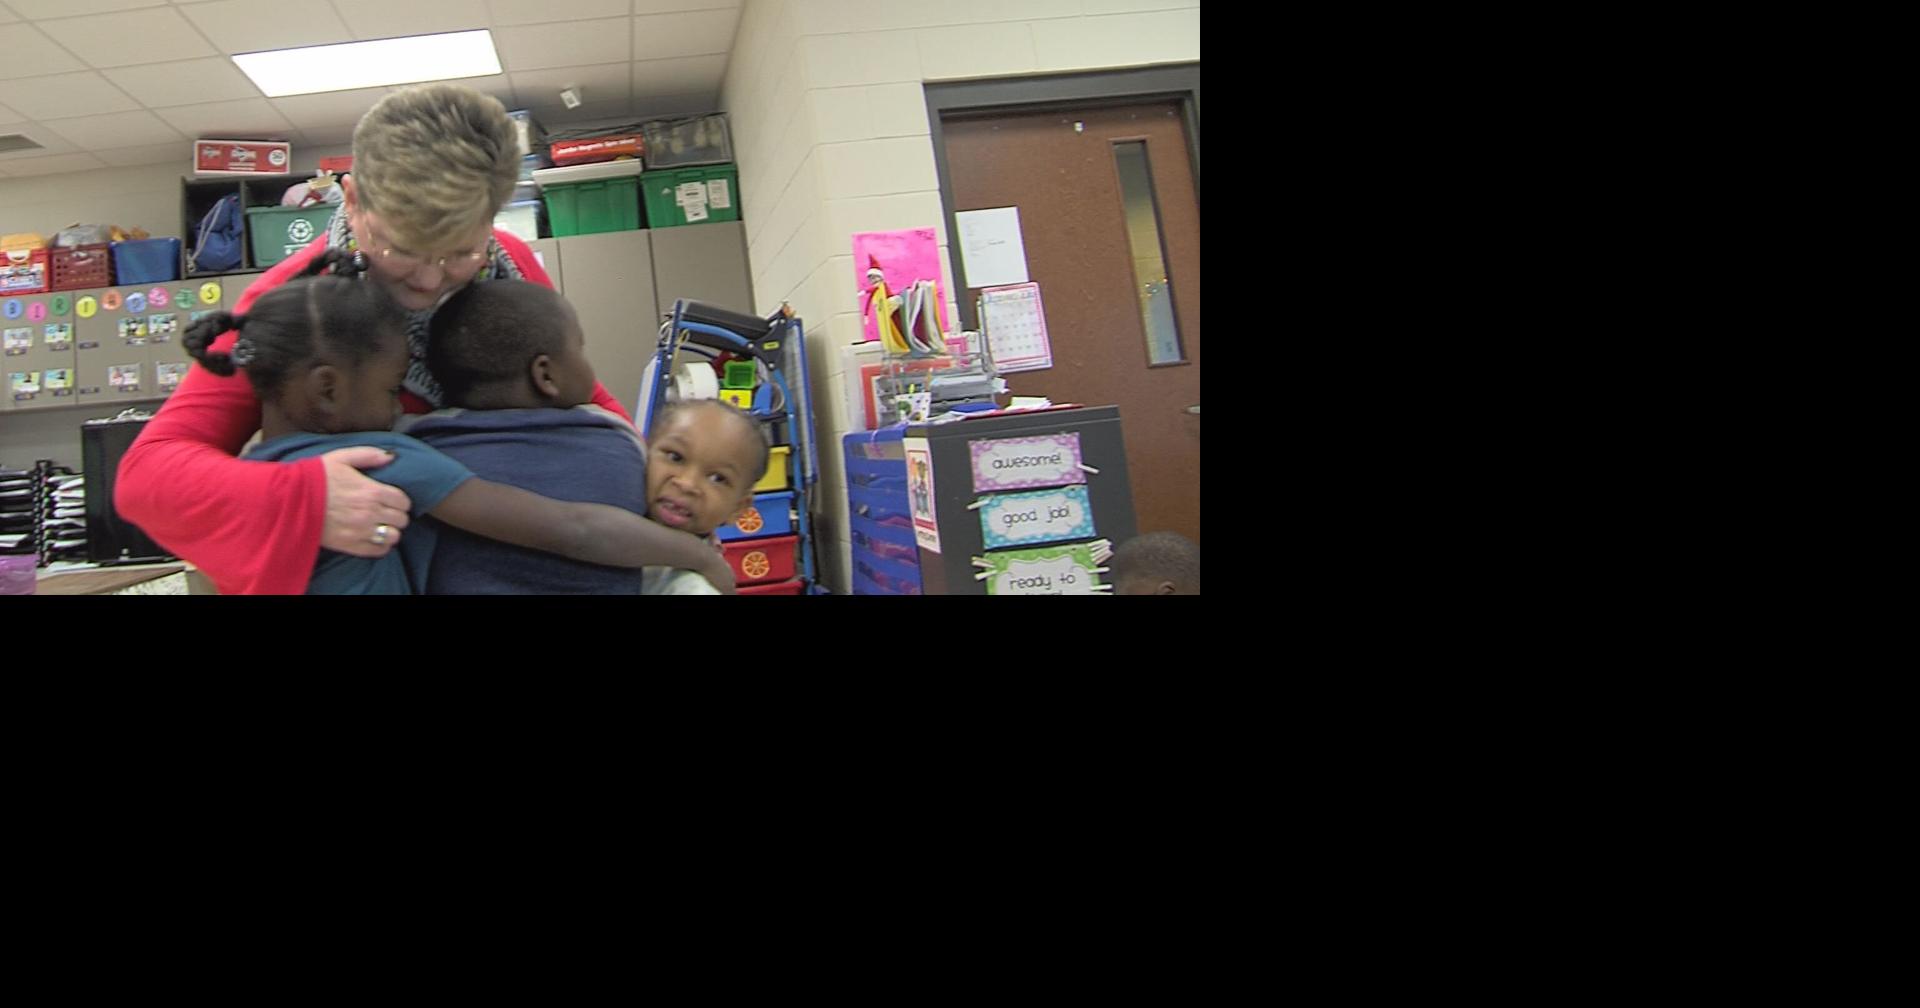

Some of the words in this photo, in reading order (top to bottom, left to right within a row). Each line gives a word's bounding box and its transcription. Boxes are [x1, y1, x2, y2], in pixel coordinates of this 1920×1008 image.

[992, 452, 1062, 470] awesome!
[1002, 509, 1038, 528] good
[1045, 505, 1070, 523] job!
[1009, 574, 1052, 591] ready
[1059, 572, 1077, 585] to
